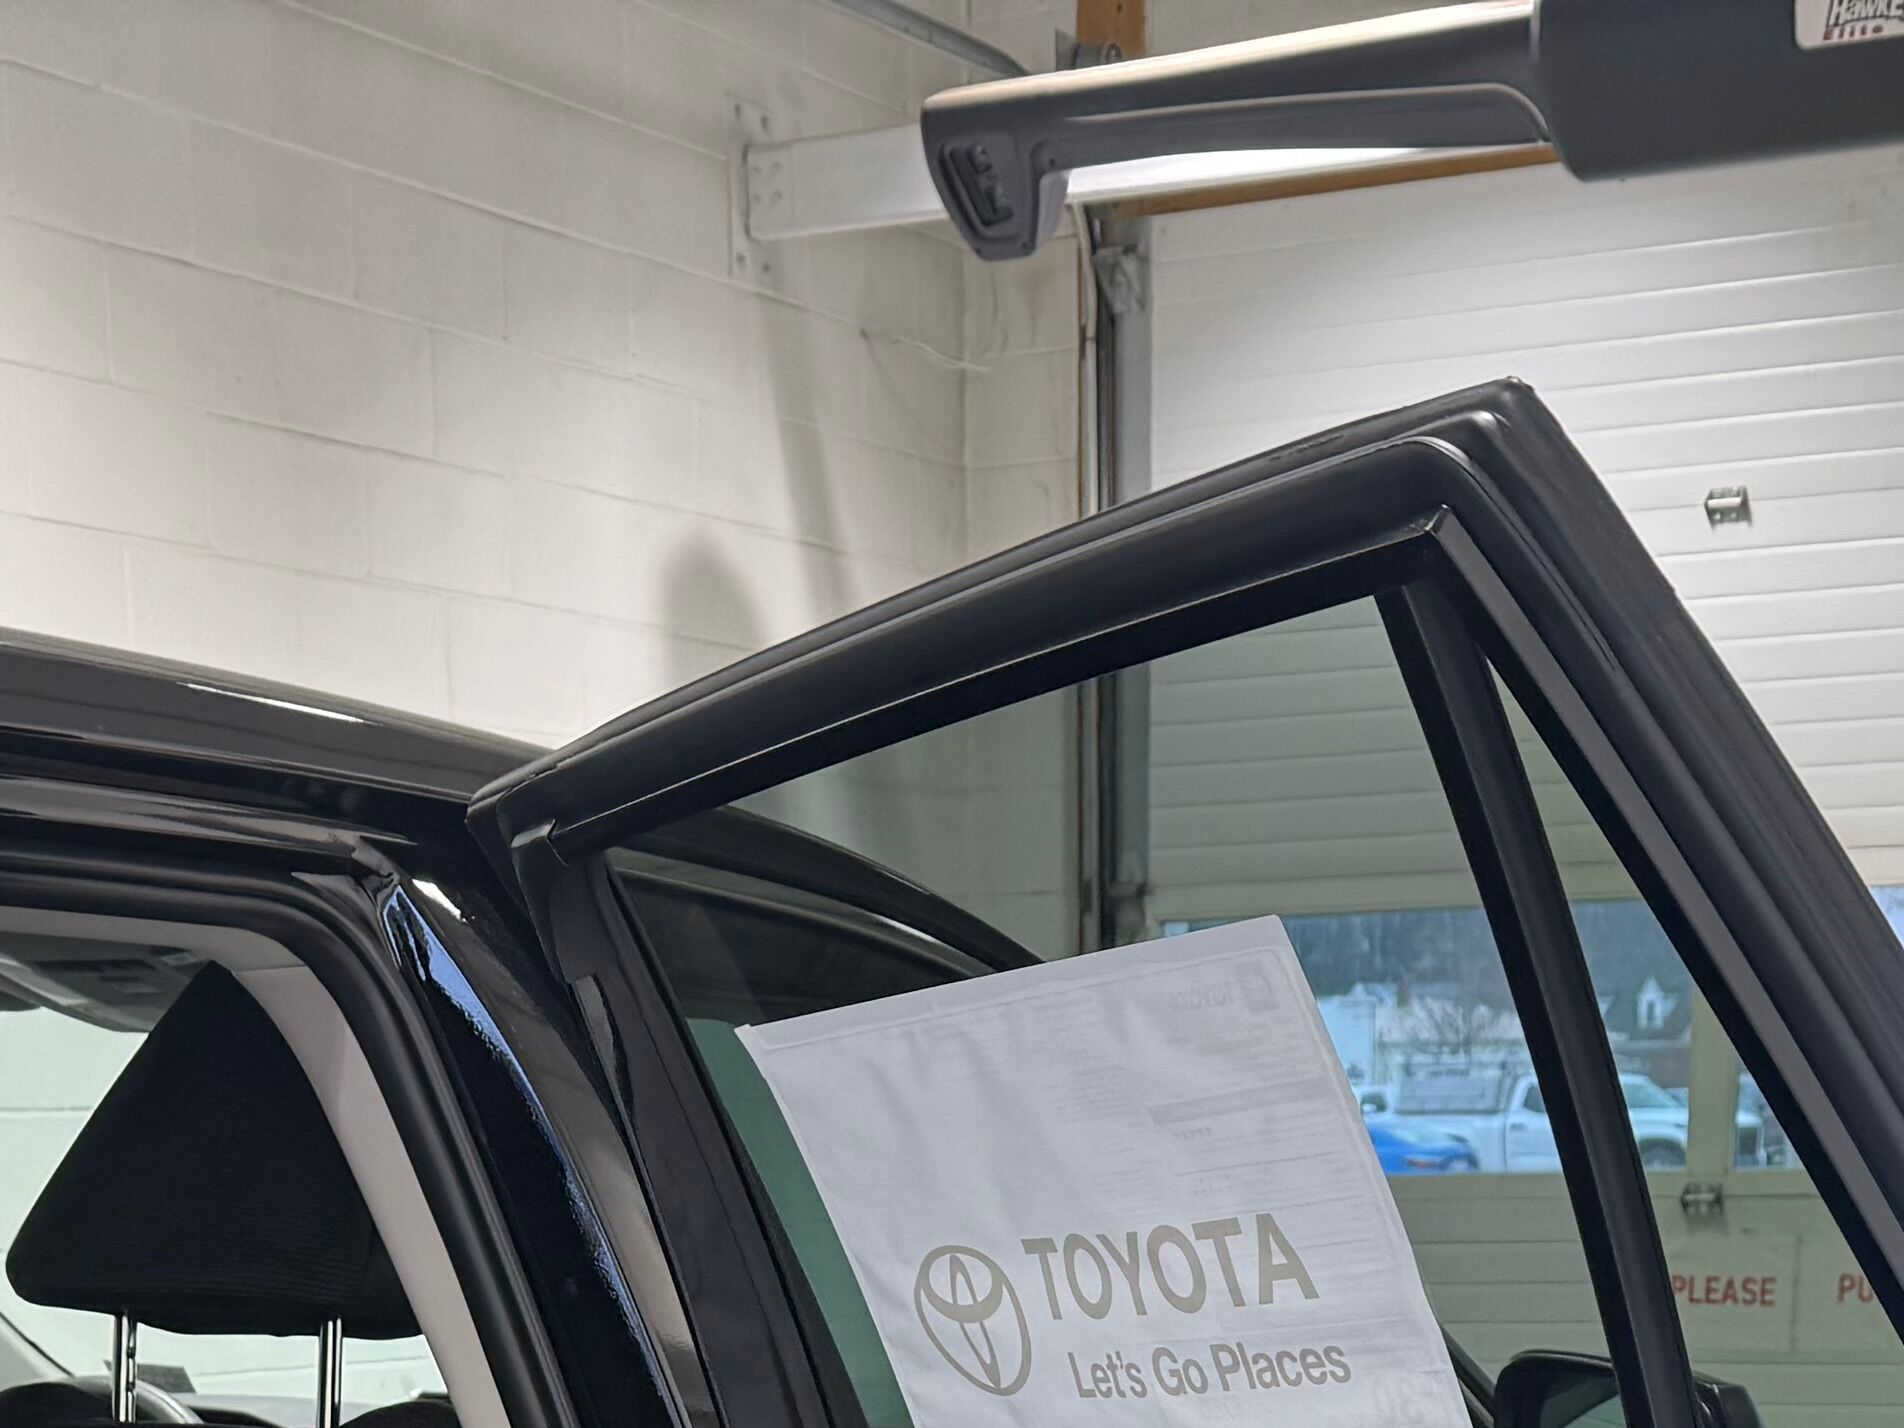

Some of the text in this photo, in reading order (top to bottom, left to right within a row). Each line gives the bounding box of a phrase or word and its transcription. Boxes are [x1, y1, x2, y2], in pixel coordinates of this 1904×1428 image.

[1020, 1213, 1320, 1320] TOYOTA
[1671, 1274, 1777, 1306] PLEASE
[1836, 1273, 1874, 1304] PU
[1068, 1342, 1352, 1399] Let's Go Places
